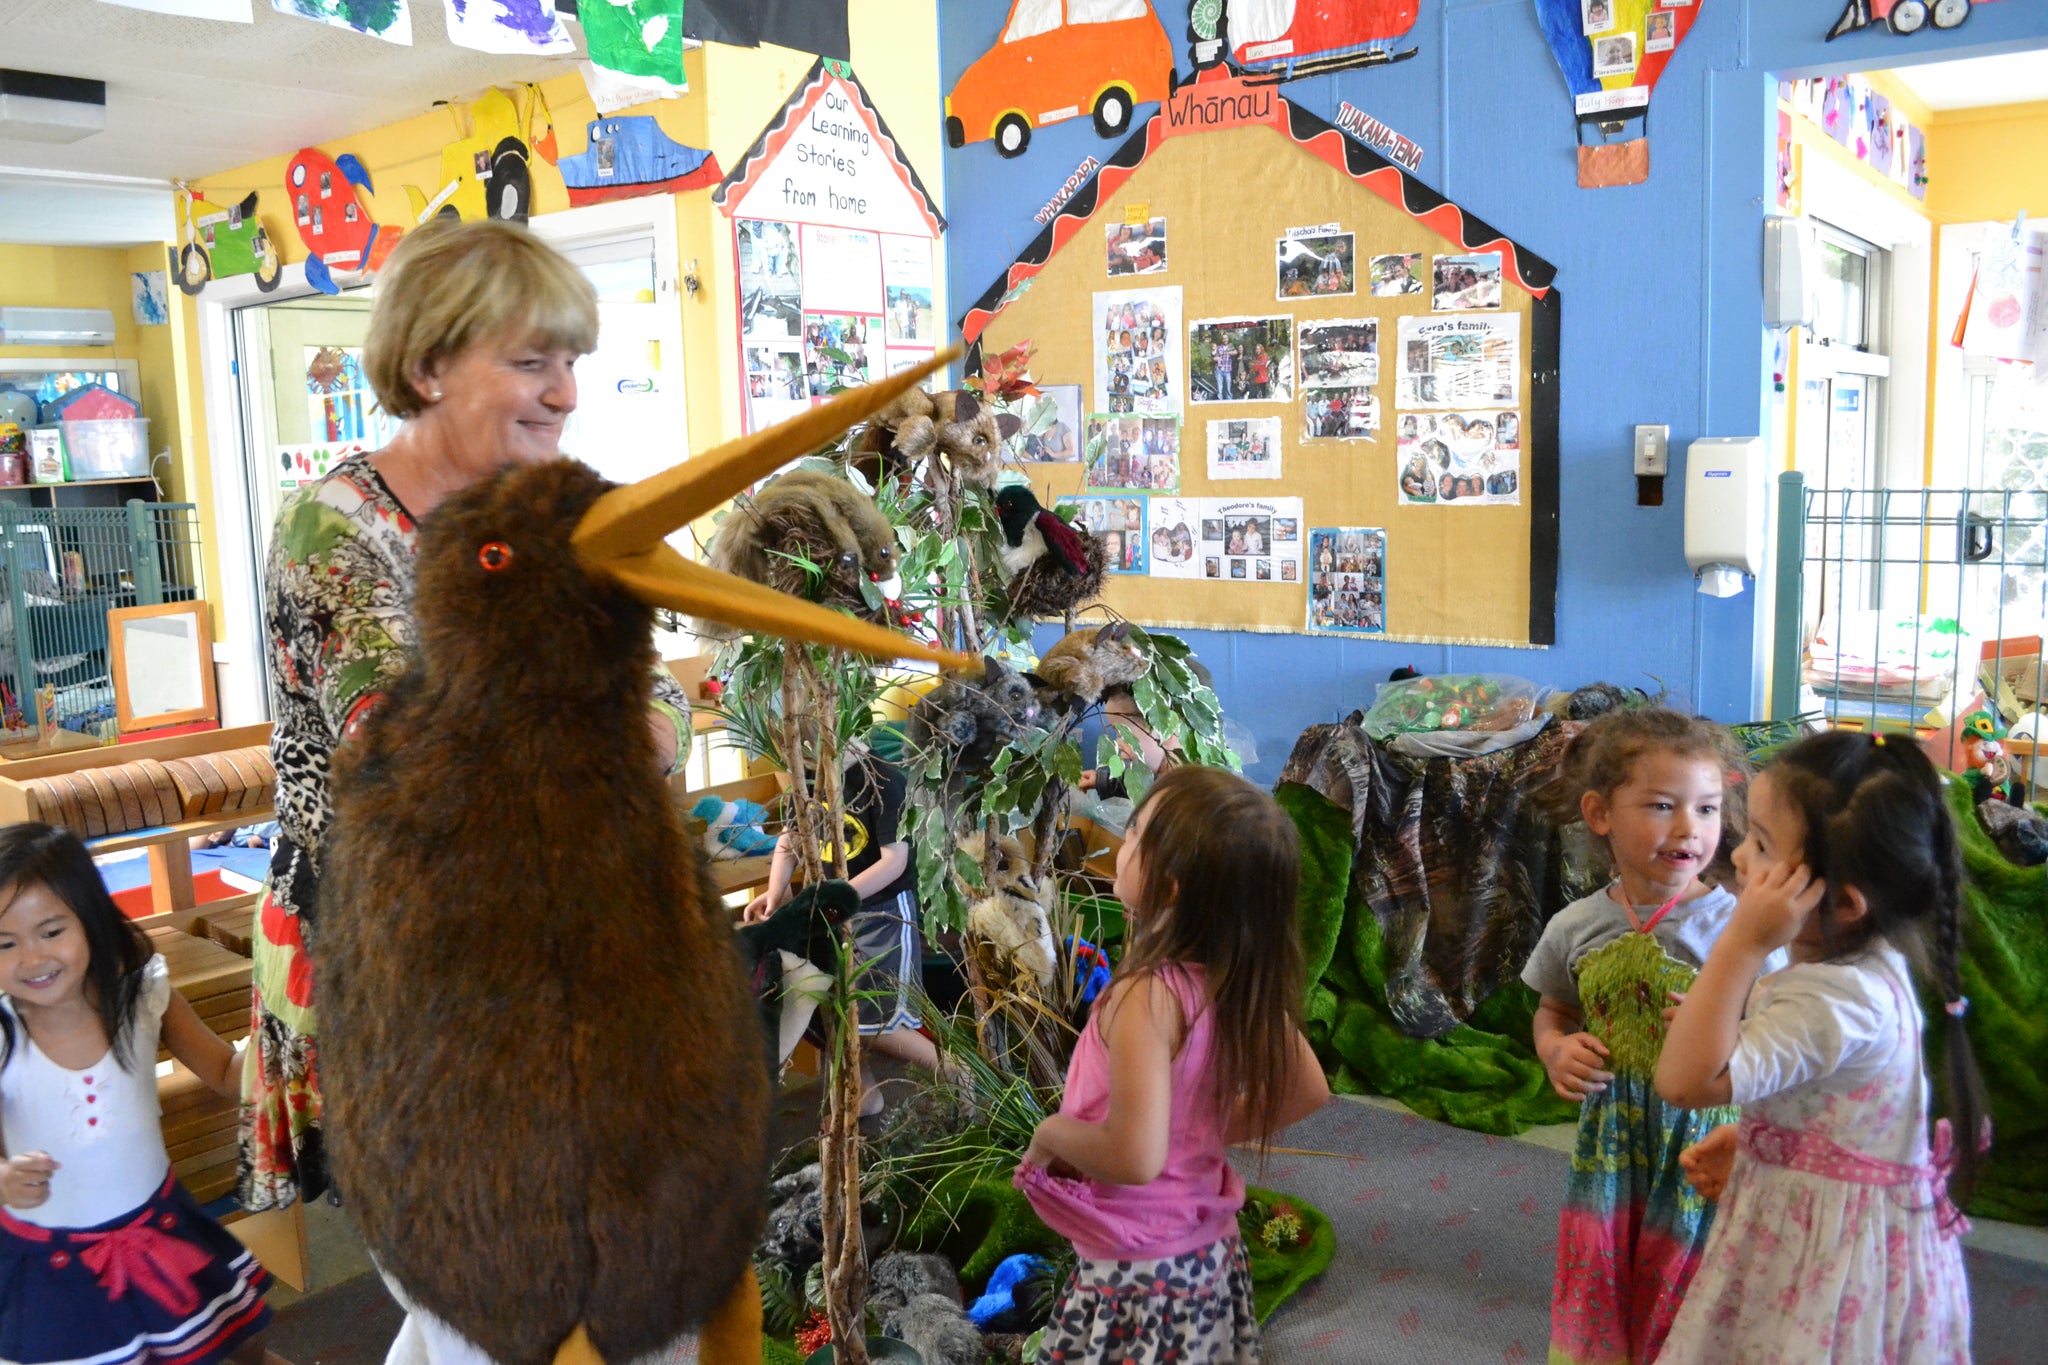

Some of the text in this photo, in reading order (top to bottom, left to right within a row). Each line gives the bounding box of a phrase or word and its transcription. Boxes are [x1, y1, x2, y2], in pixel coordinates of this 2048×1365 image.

[1247, 48, 1265, 59] June
[825, 92, 849, 113] Our
[1168, 90, 1270, 127] Whānau
[1578, 97, 1601, 112] July
[811, 111, 869, 156] Learning
[1336, 102, 1423, 171] TUAKANA-TEINA
[797, 143, 856, 177] Stories
[782, 178, 867, 214] from home
[1035, 156, 1099, 224] WHAKAPAPA
[1217, 502, 1278, 515] Theodore's family
